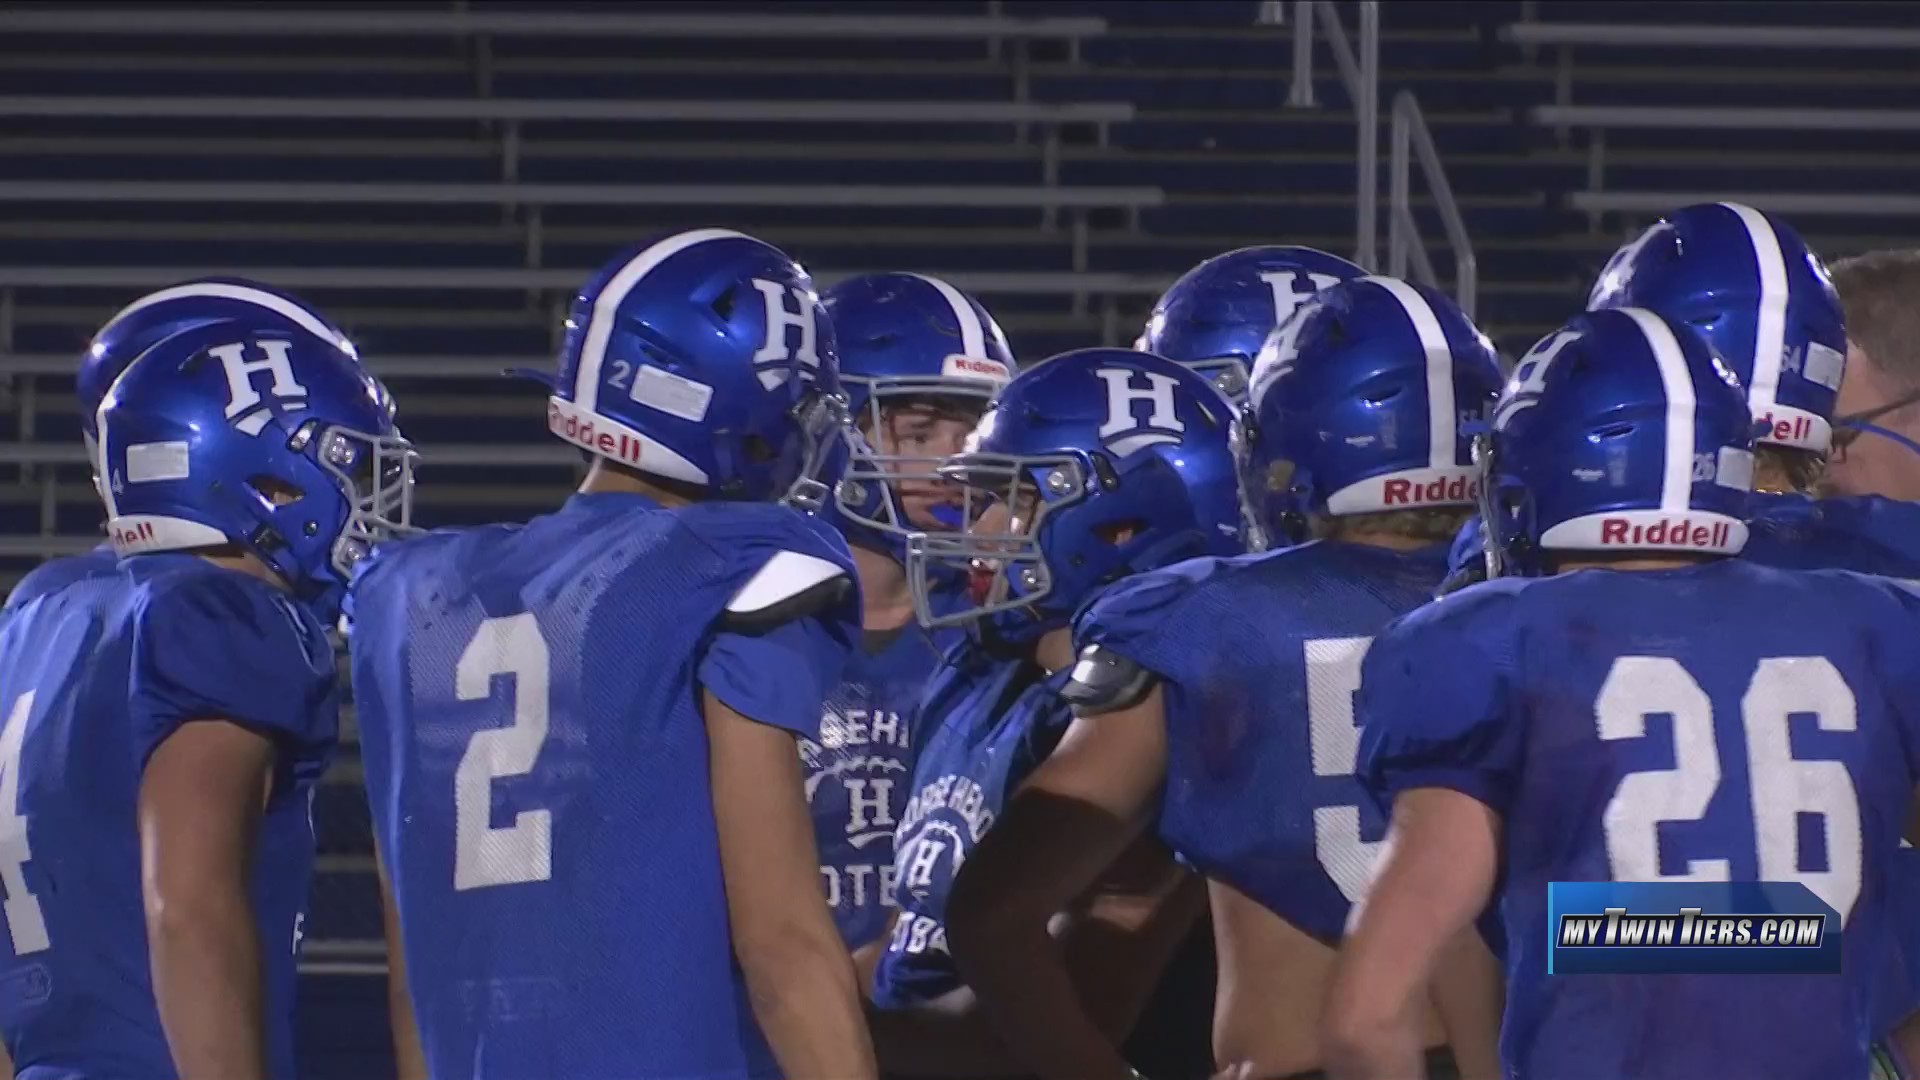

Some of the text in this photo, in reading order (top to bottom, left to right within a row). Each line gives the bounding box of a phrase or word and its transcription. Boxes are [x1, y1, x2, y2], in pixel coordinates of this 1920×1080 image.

[751, 277, 821, 370] H
[207, 338, 309, 421] H
[606, 359, 631, 390] 2
[1095, 368, 1186, 439] H
[1601, 518, 1729, 549] Riddell
[454, 611, 552, 891] 2
[843, 778, 896, 834] H
[1595, 655, 1863, 925] 26
